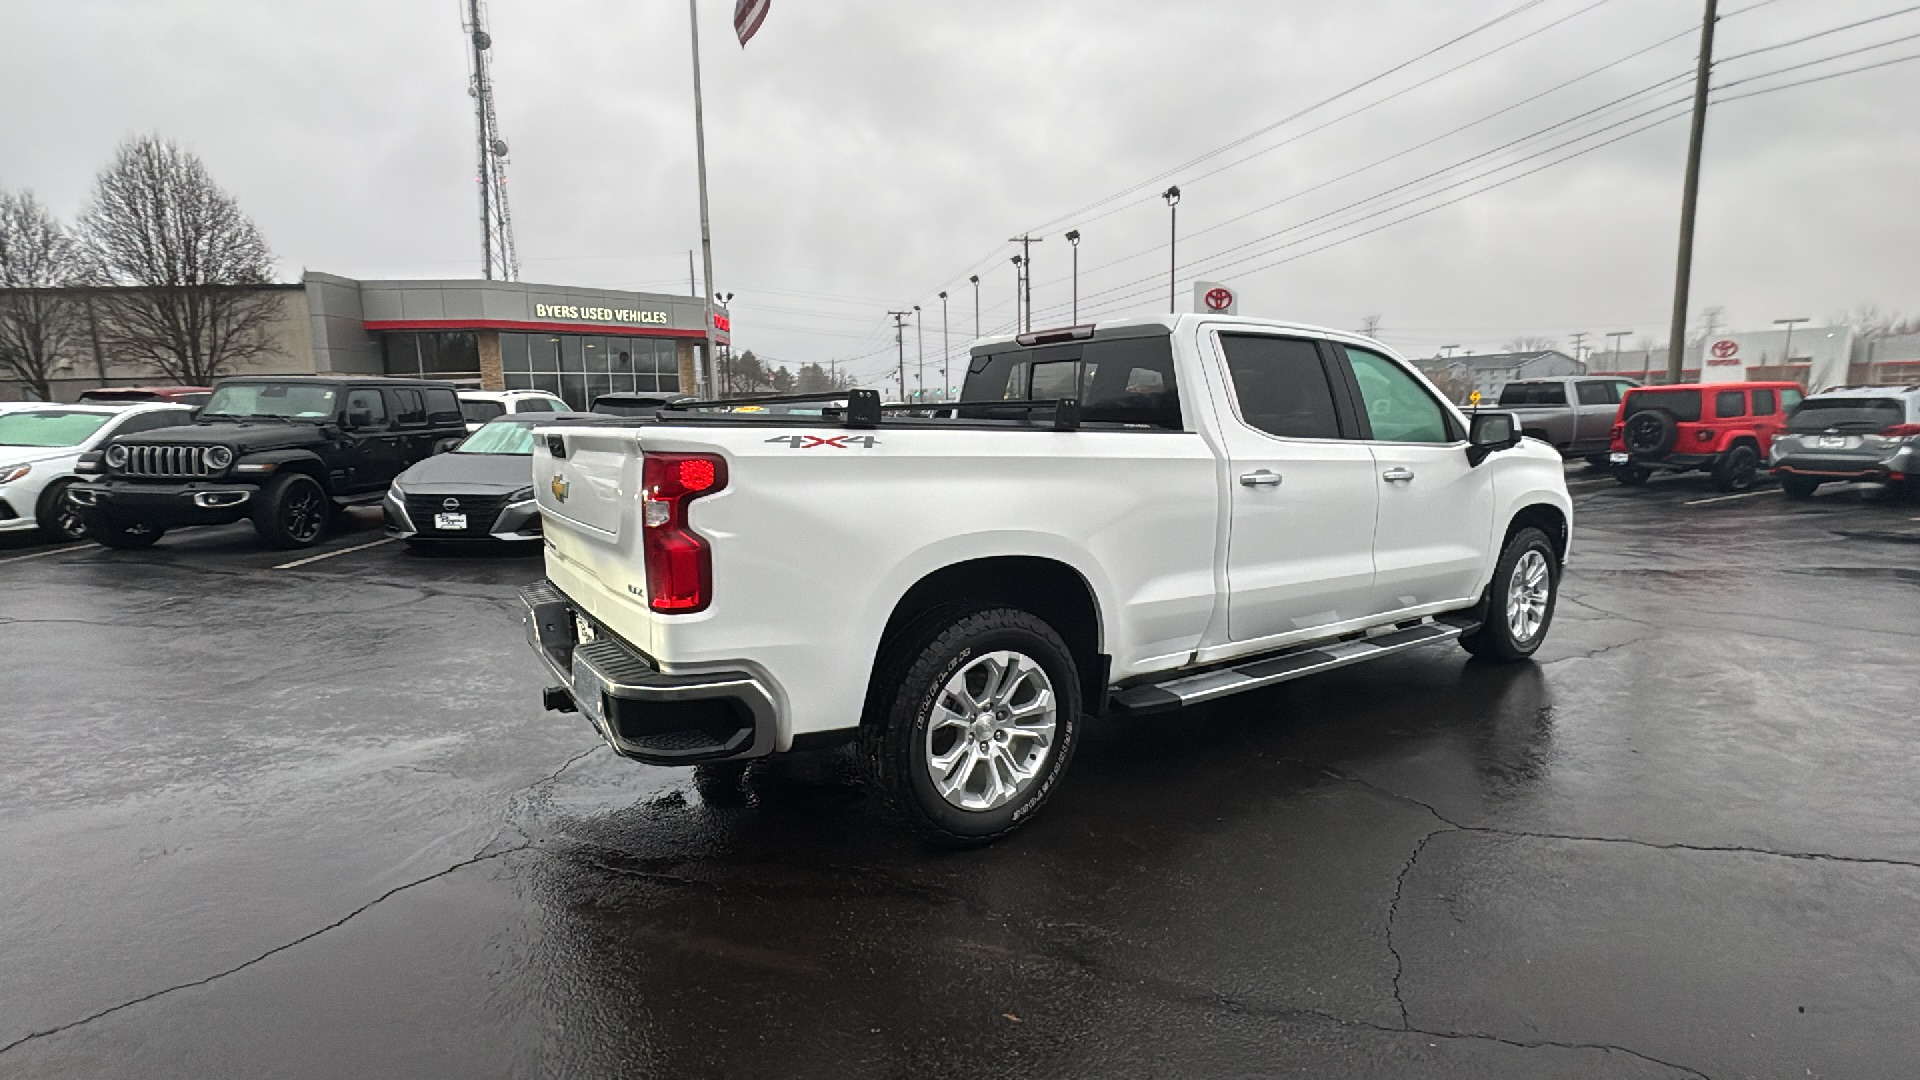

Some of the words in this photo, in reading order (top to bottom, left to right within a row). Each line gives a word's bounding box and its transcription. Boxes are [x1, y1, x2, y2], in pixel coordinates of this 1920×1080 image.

[536, 303, 579, 319] BYERS
[580, 307, 613, 321] USED
[614, 309, 667, 324] VEHICLES
[764, 435, 882, 449] 4X4
